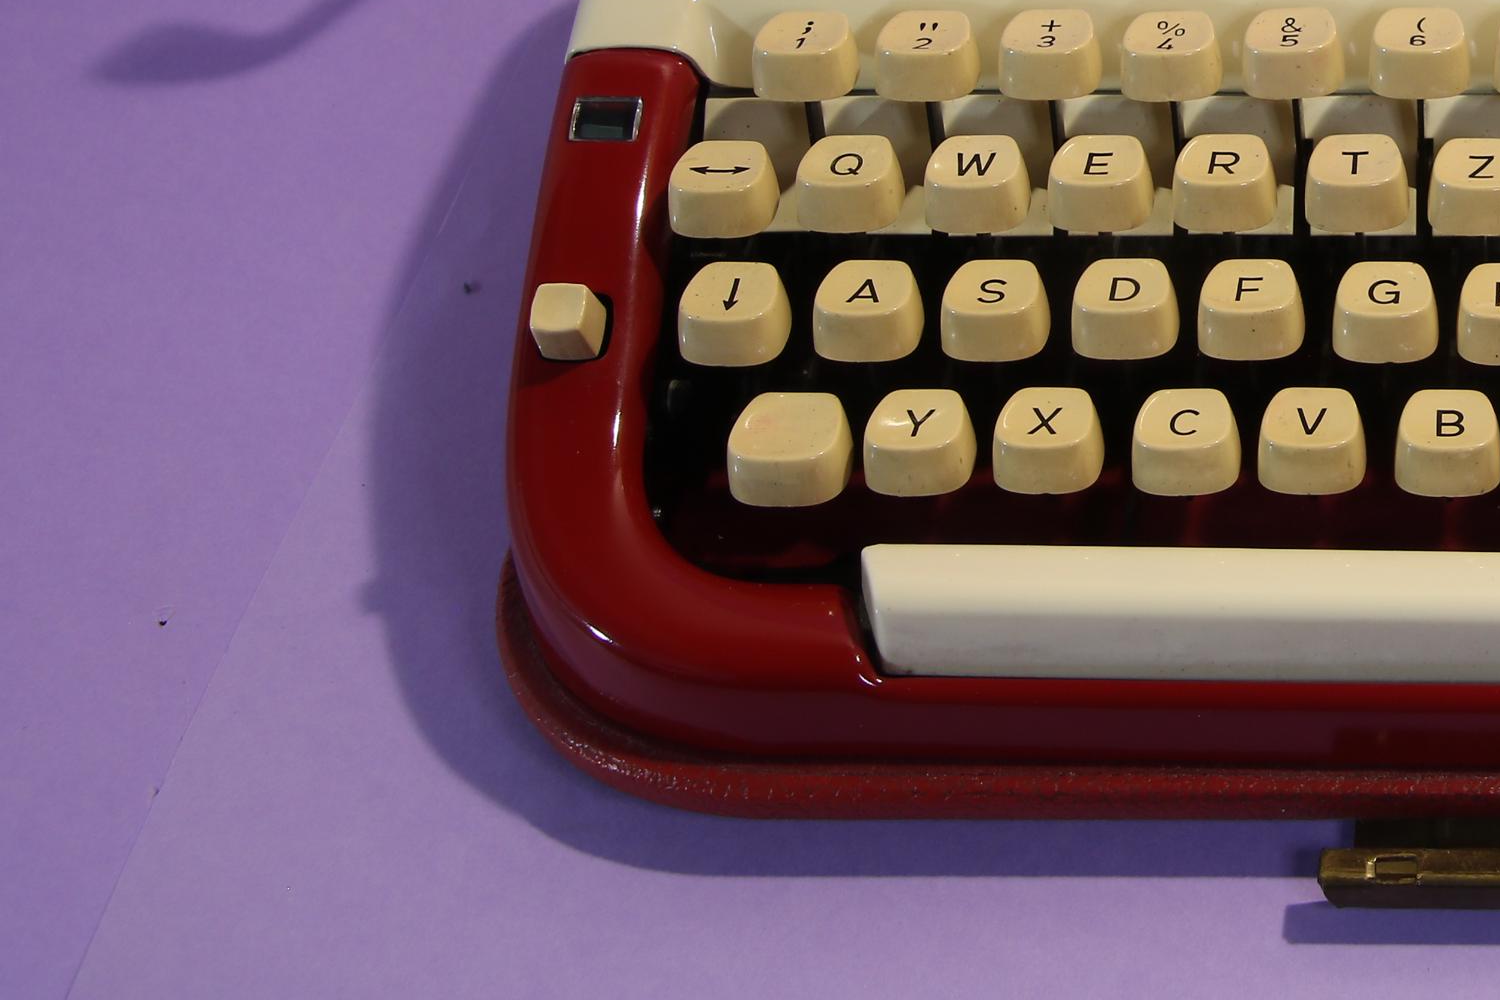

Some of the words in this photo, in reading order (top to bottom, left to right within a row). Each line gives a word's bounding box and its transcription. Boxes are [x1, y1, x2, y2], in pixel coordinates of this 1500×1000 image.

[801, 20, 815, 35] ;
[1041, 19, 1062, 33] +
[1157, 20, 1186, 37] %
[1280, 17, 1302, 33] &
[1416, 17, 1426, 33] (
[796, 37, 806, 49] 1
[913, 37, 933, 50] 2
[1036, 35, 1056, 48] 3
[1156, 37, 1174, 50] 4
[1280, 34, 1299, 47] 5
[1409, 34, 1426, 47] 6
[829, 153, 864, 176] Q
[957, 152, 997, 177] W
[1083, 152, 1114, 176] E
[1207, 151, 1241, 175] R
[1341, 151, 1370, 175] T
[1468, 155, 1495, 179] Z
[845, 278, 880, 304] A
[976, 278, 1008, 304] S
[1108, 277, 1141, 302] D
[1234, 276, 1264, 302] F
[1367, 279, 1401, 305] G
[906, 408, 936, 438] Y
[1027, 407, 1063, 435] X
[1169, 409, 1200, 436] C
[1296, 407, 1328, 436] V
[1435, 409, 1465, 438] B
